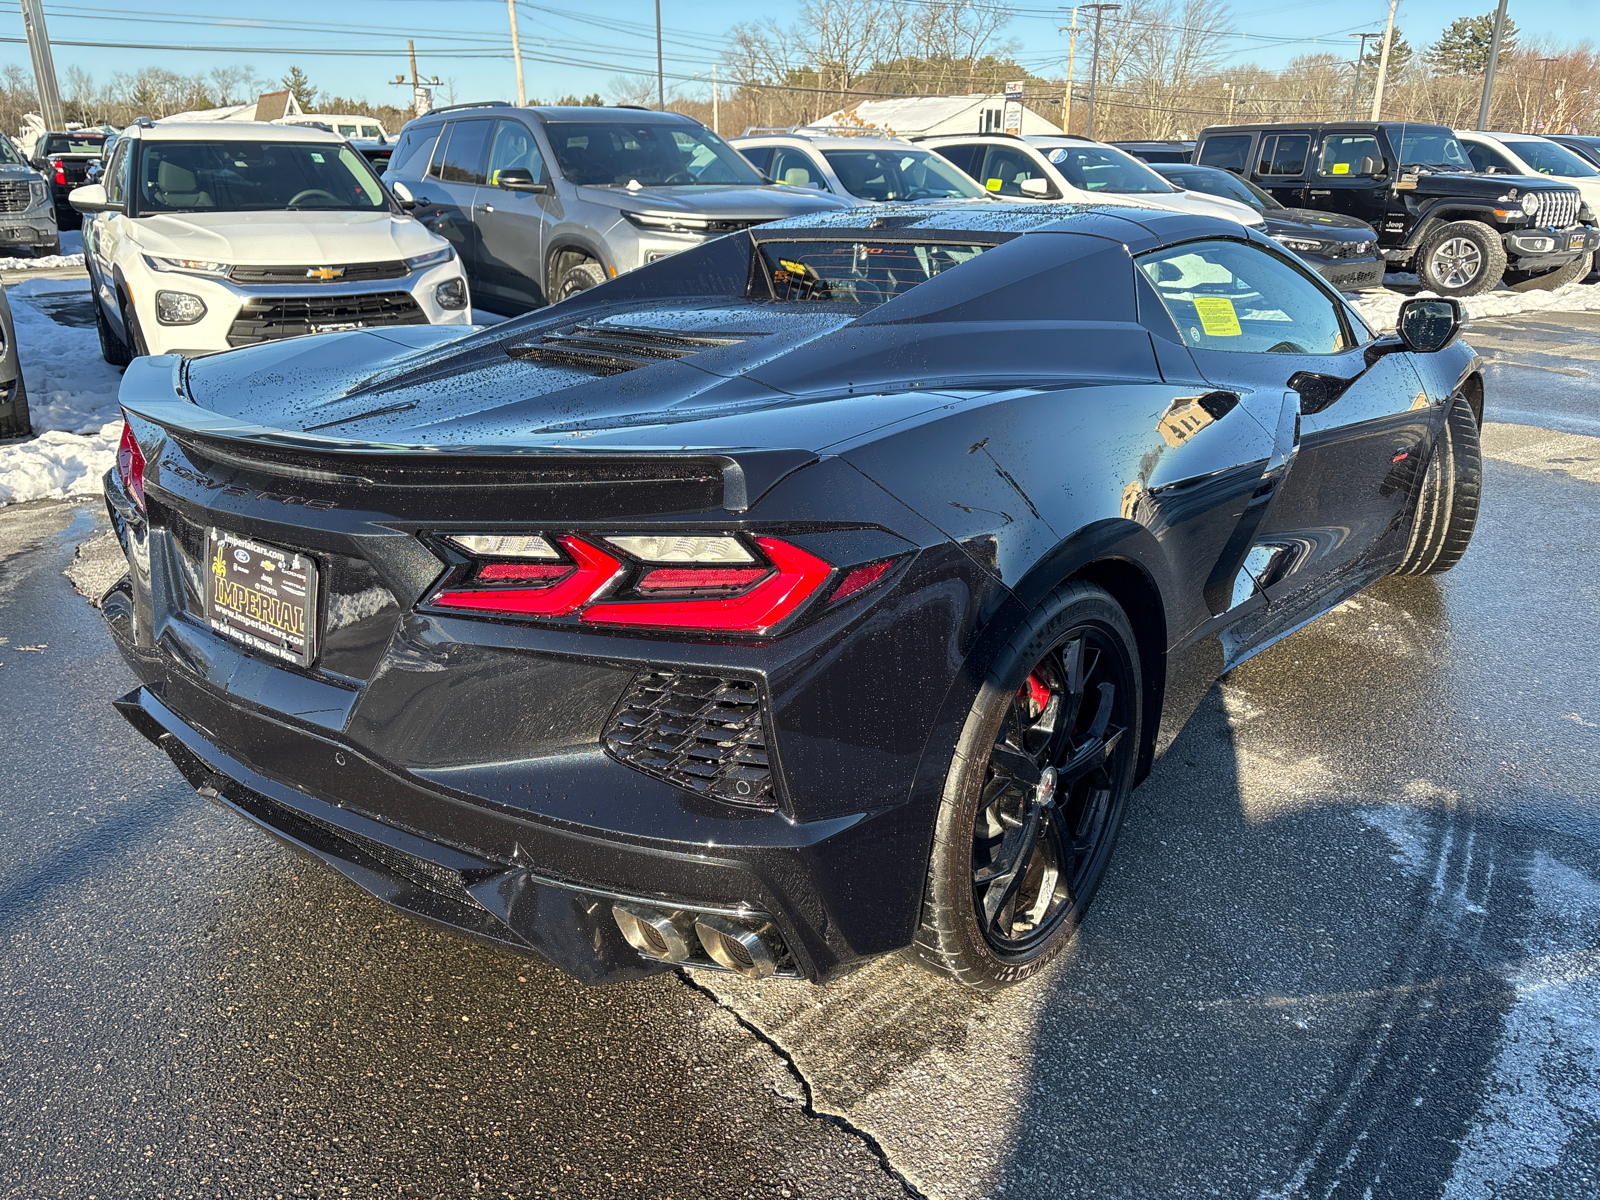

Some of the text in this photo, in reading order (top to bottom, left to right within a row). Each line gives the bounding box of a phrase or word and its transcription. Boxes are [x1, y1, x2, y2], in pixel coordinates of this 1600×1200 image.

[1386, 220, 1404, 228] Jeep
[224, 532, 285, 561] Imperialcars.com
[214, 576, 305, 636] IMPERIAL
